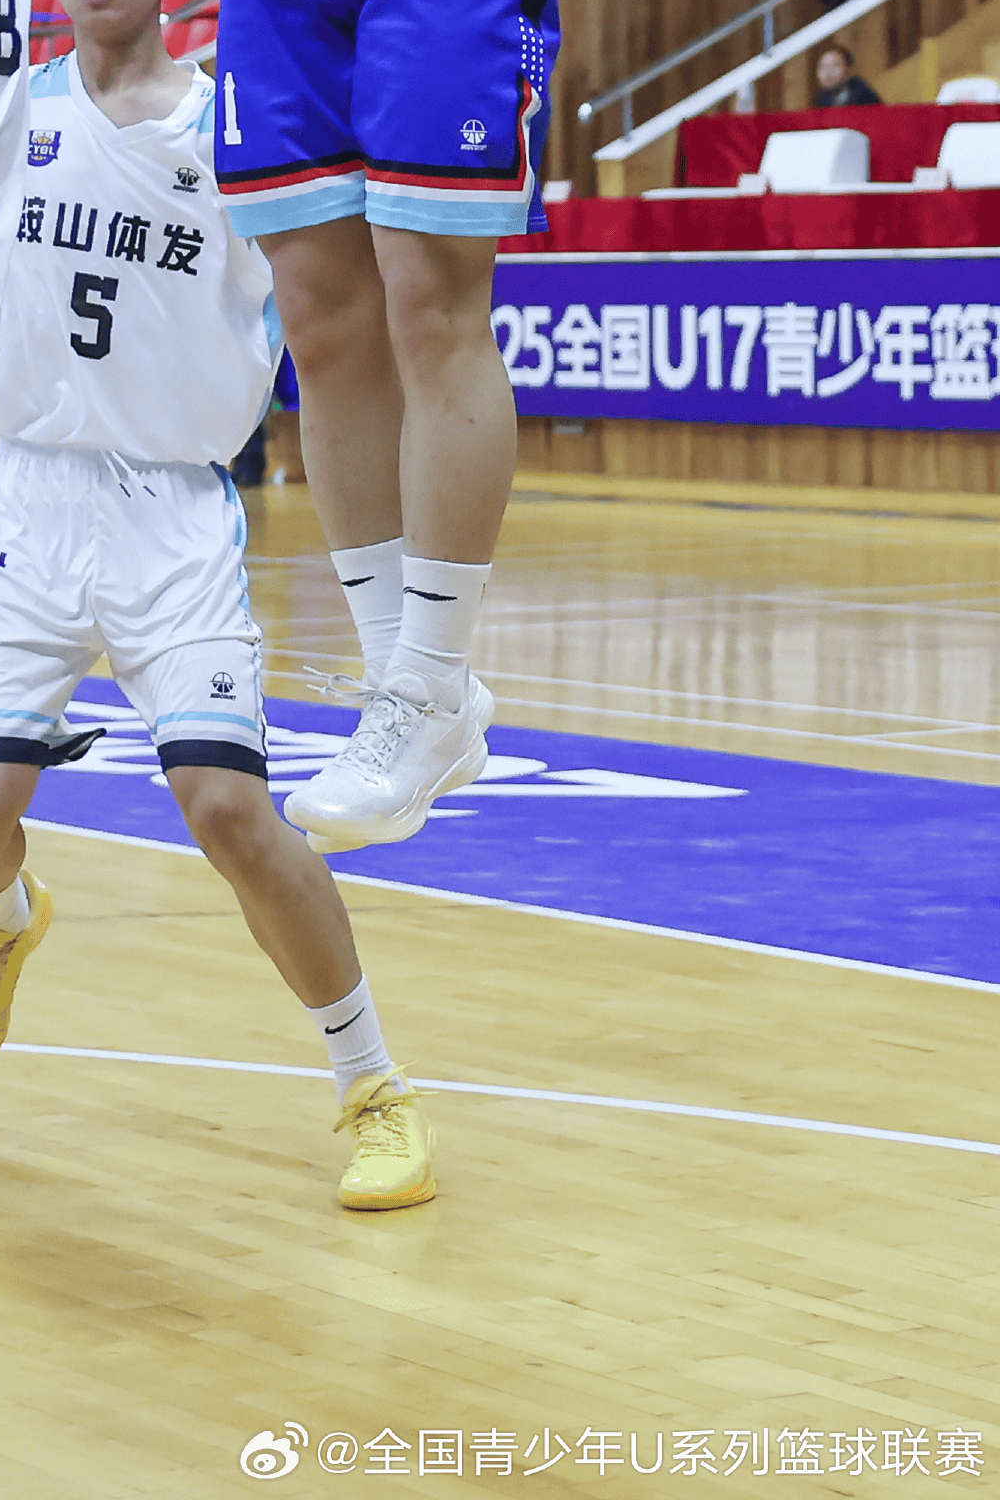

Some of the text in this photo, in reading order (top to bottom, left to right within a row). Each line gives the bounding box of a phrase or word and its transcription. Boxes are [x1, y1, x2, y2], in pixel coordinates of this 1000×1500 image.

[224, 71, 242, 145] 1
[70, 271, 119, 360] 5
[491, 303, 1000, 399] 25全国U17青少年篮
